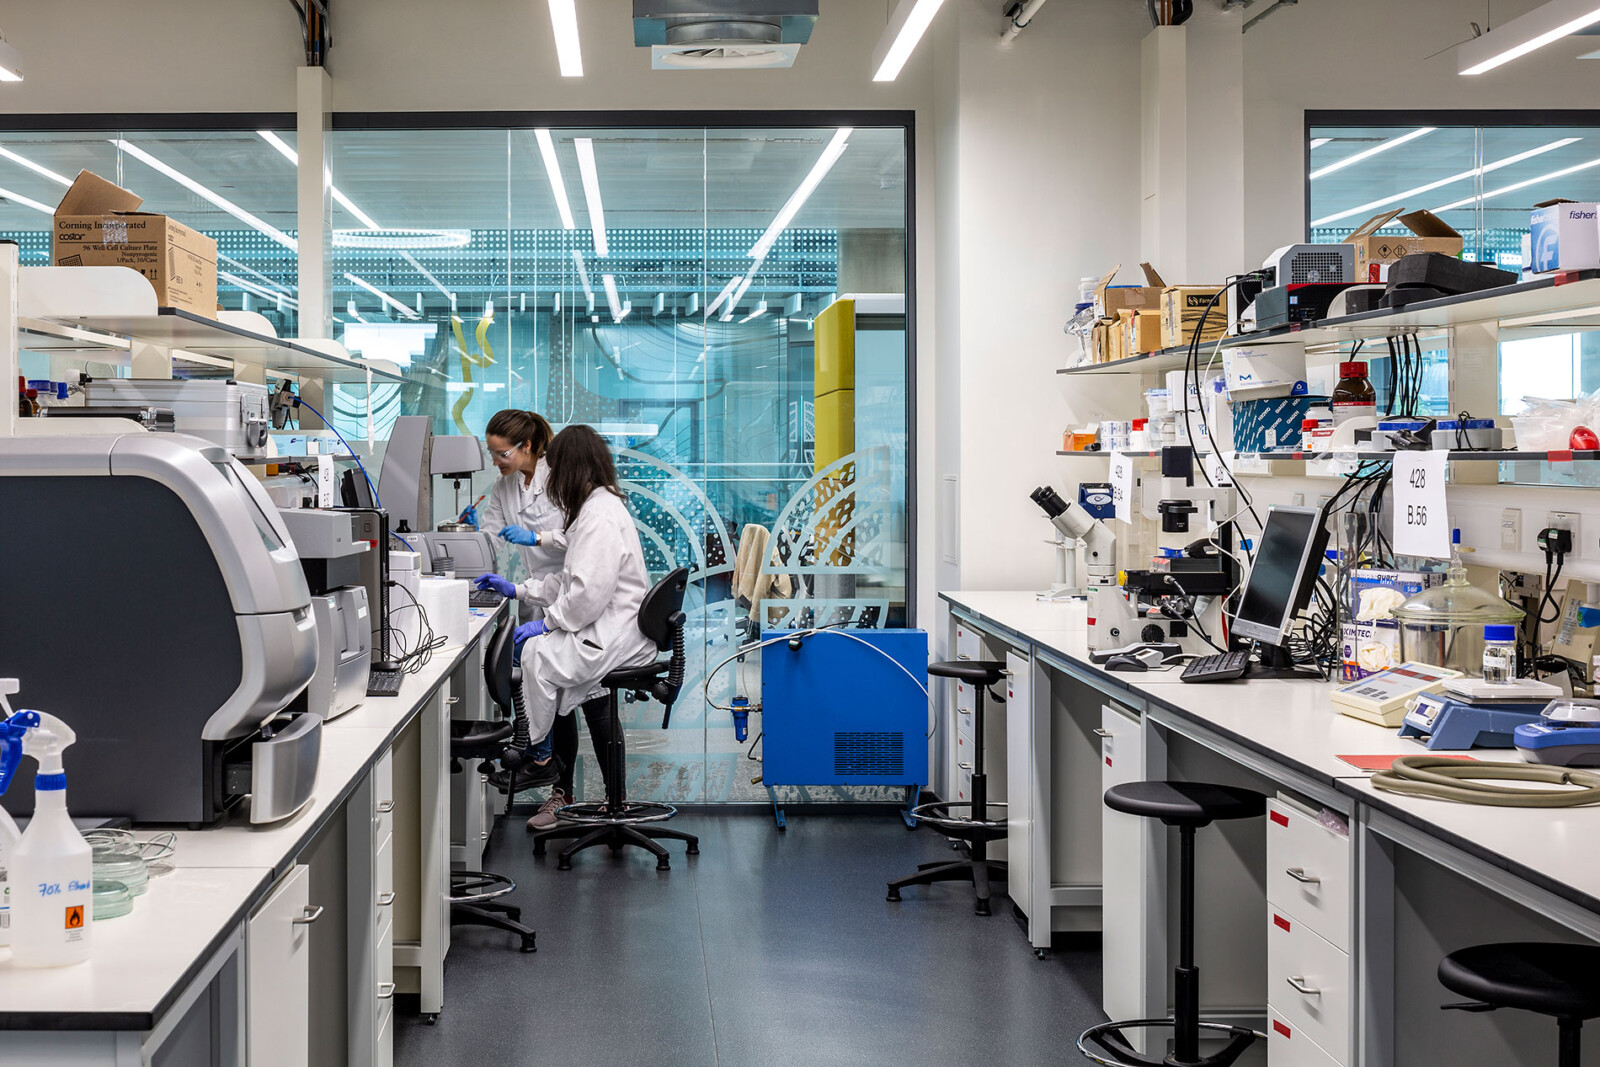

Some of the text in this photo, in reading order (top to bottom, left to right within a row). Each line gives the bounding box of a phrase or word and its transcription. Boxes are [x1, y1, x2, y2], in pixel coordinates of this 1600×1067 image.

[58, 221, 146, 230] Corning Incorporated
[59, 233, 85, 241] costar
[1275, 400, 1288, 414] QIAGEN
[1286, 410, 1300, 424] QIAGEN
[1280, 428, 1293, 442] QIAGEN
[1410, 468, 1426, 488] 428
[1408, 504, 1427, 526] B.56
[38, 883, 62, 896] 70%
